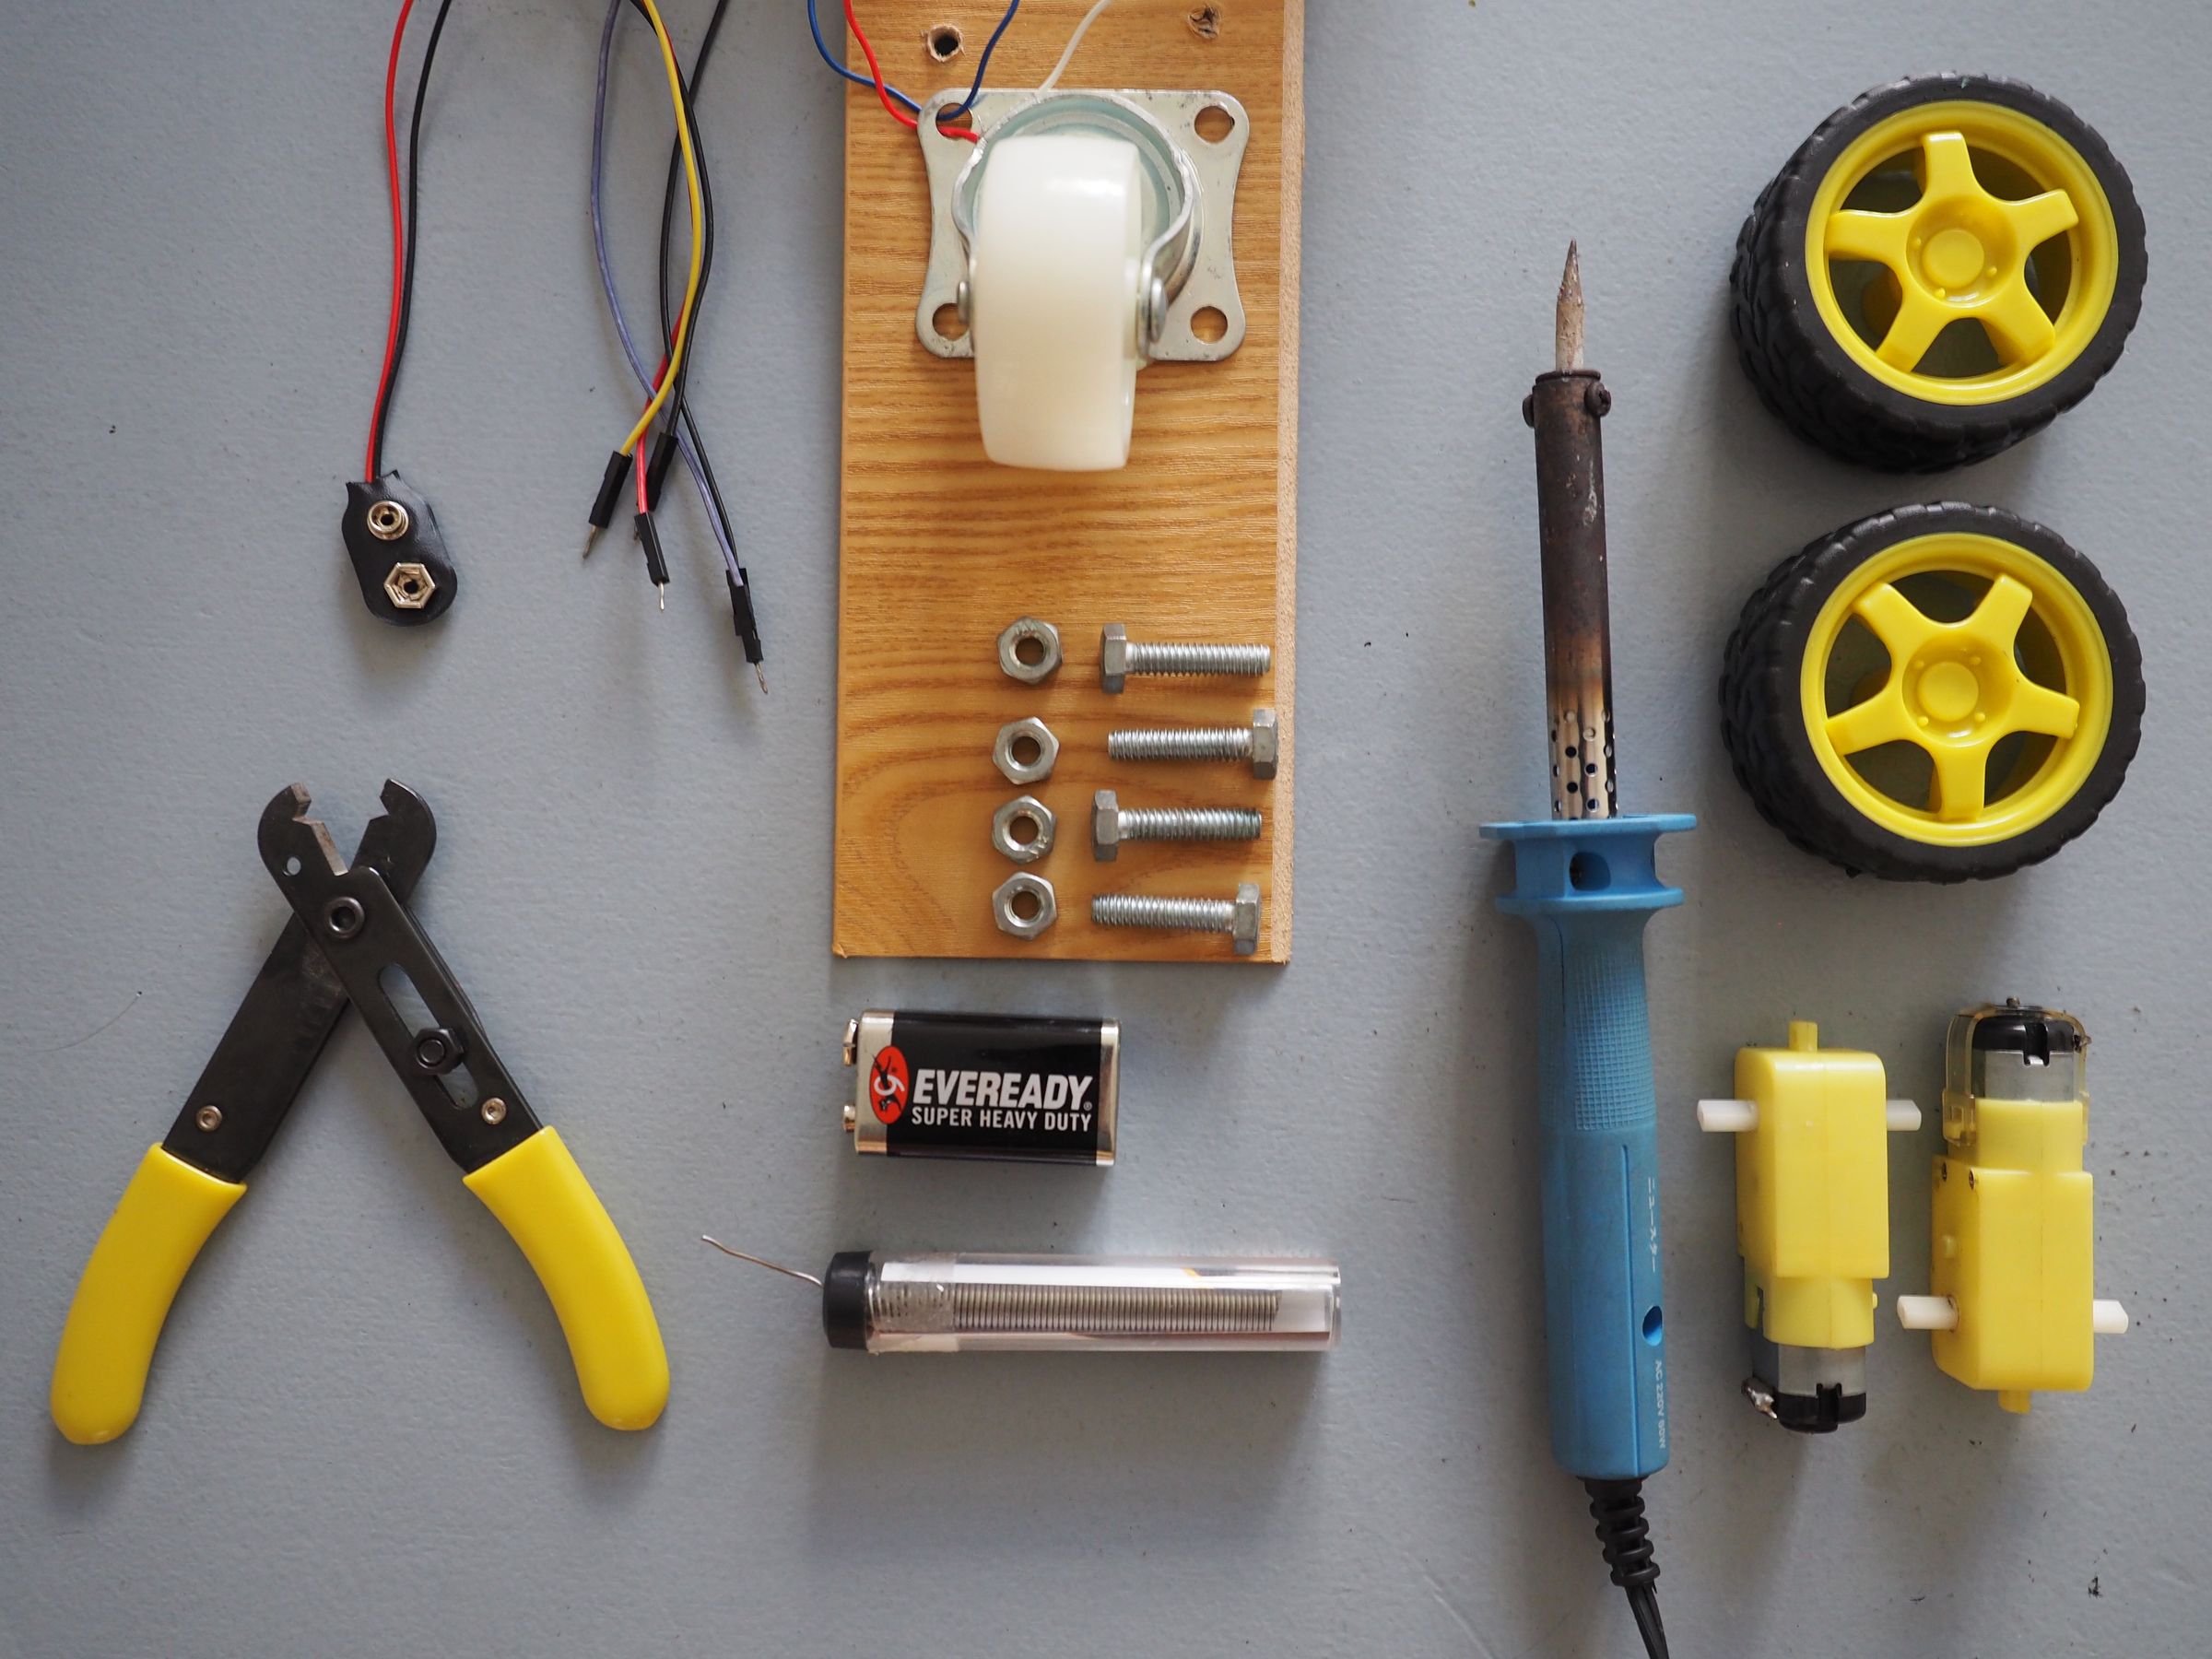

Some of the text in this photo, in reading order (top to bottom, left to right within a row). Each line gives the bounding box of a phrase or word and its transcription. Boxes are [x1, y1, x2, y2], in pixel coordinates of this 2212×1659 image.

[912, 1068, 1093, 1111] EVEREADY
[912, 1106, 1091, 1132] SUPER HEAVY DUTY
[1648, 1177, 1657, 1273] ニュースター
[1655, 1359, 1663, 1381] AC
[1656, 1382, 1665, 1416] 220V
